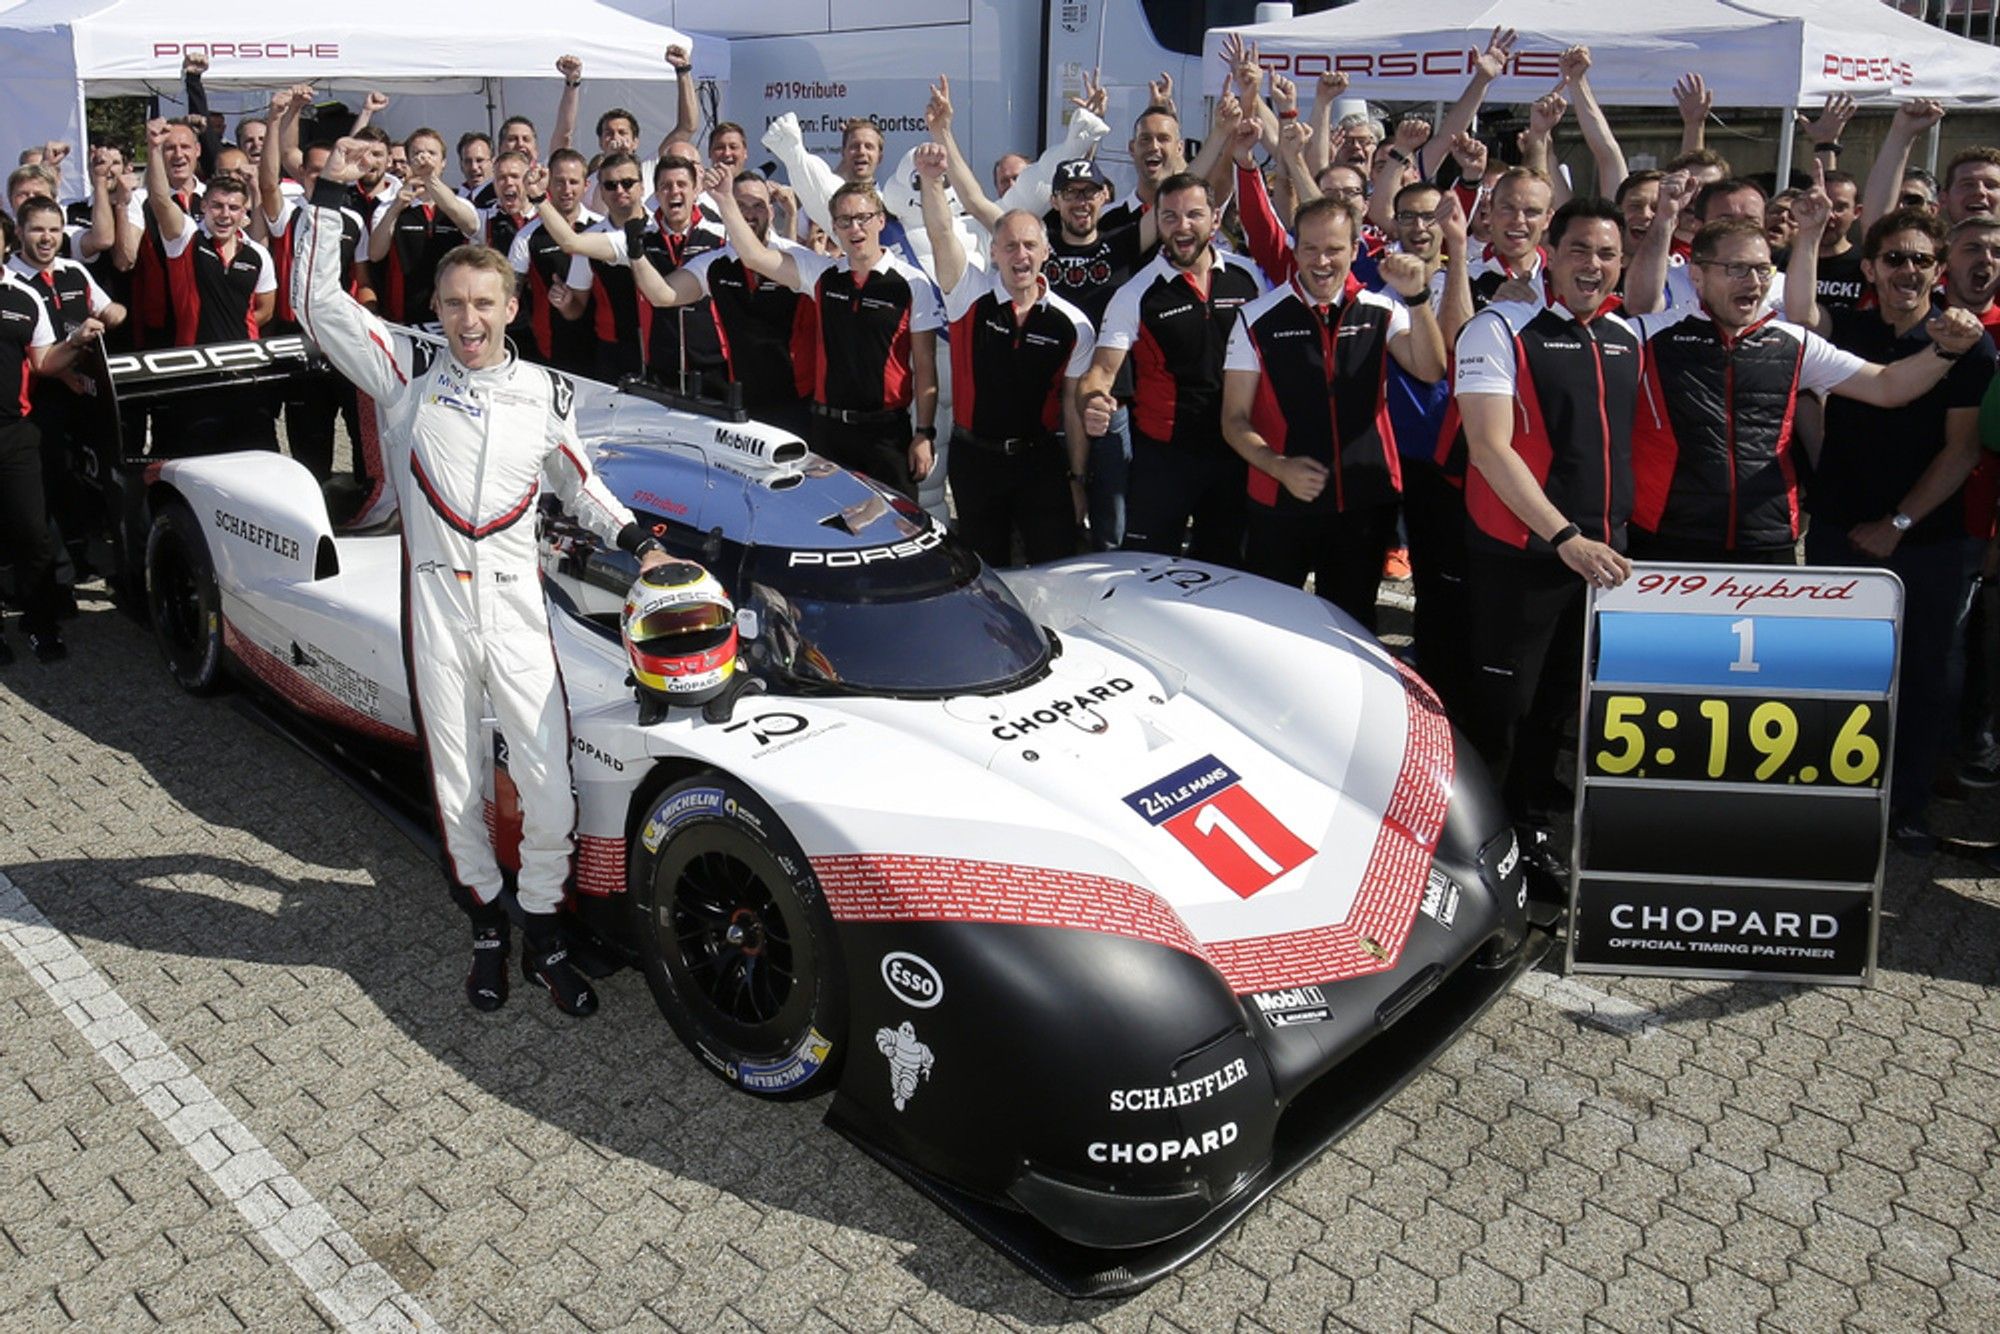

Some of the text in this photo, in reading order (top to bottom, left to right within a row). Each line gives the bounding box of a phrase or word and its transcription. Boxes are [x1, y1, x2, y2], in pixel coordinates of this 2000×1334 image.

[1823, 53, 1914, 86] PORSCHE
[765, 82, 847, 98] #919tribute
[214, 509, 300, 561] SCHAEFFLER
[1637, 574, 1859, 610] 919 hybrid
[1729, 618, 1760, 672] 1
[992, 678, 1134, 741] CHOPARD
[660, 793, 720, 822] MICHELIN
[1138, 767, 1228, 817] 24h LE MANS
[1193, 803, 1286, 877] 1
[1610, 904, 1839, 939] CHOPARD
[1608, 937, 1835, 959] OFFICIAL TIMING PARTNER
[890, 961, 933, 996] Esso
[1252, 989, 1306, 1011] Mobil
[1110, 1058, 1249, 1112] SCHAEFFLER
[1087, 1121, 1239, 1164] CHOPARD
